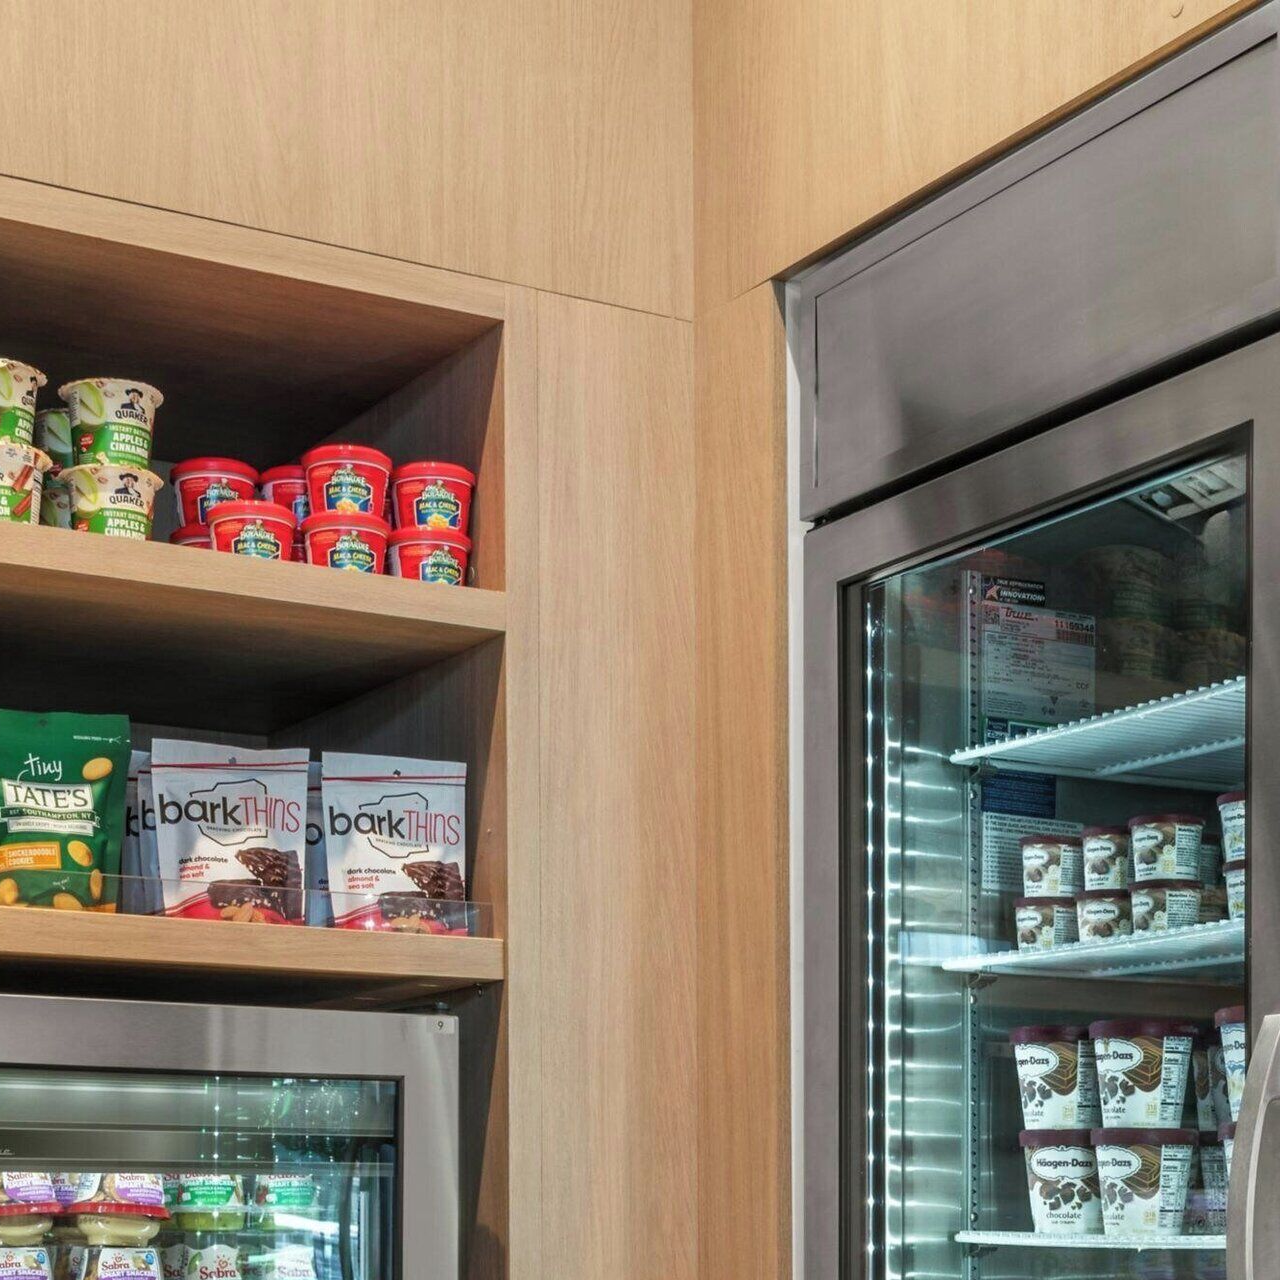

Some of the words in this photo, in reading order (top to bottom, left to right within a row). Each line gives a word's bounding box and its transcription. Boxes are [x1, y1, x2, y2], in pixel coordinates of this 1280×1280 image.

[115, 409, 148, 425] QUAKER
[109, 496, 145, 509] QUAKER
[24, 753, 63, 781] tiny
[8, 783, 89, 807] TATE'S
[1037, 1158, 1092, 1168] Häagen-Dazs
[101, 1262, 129, 1270] Sabra
